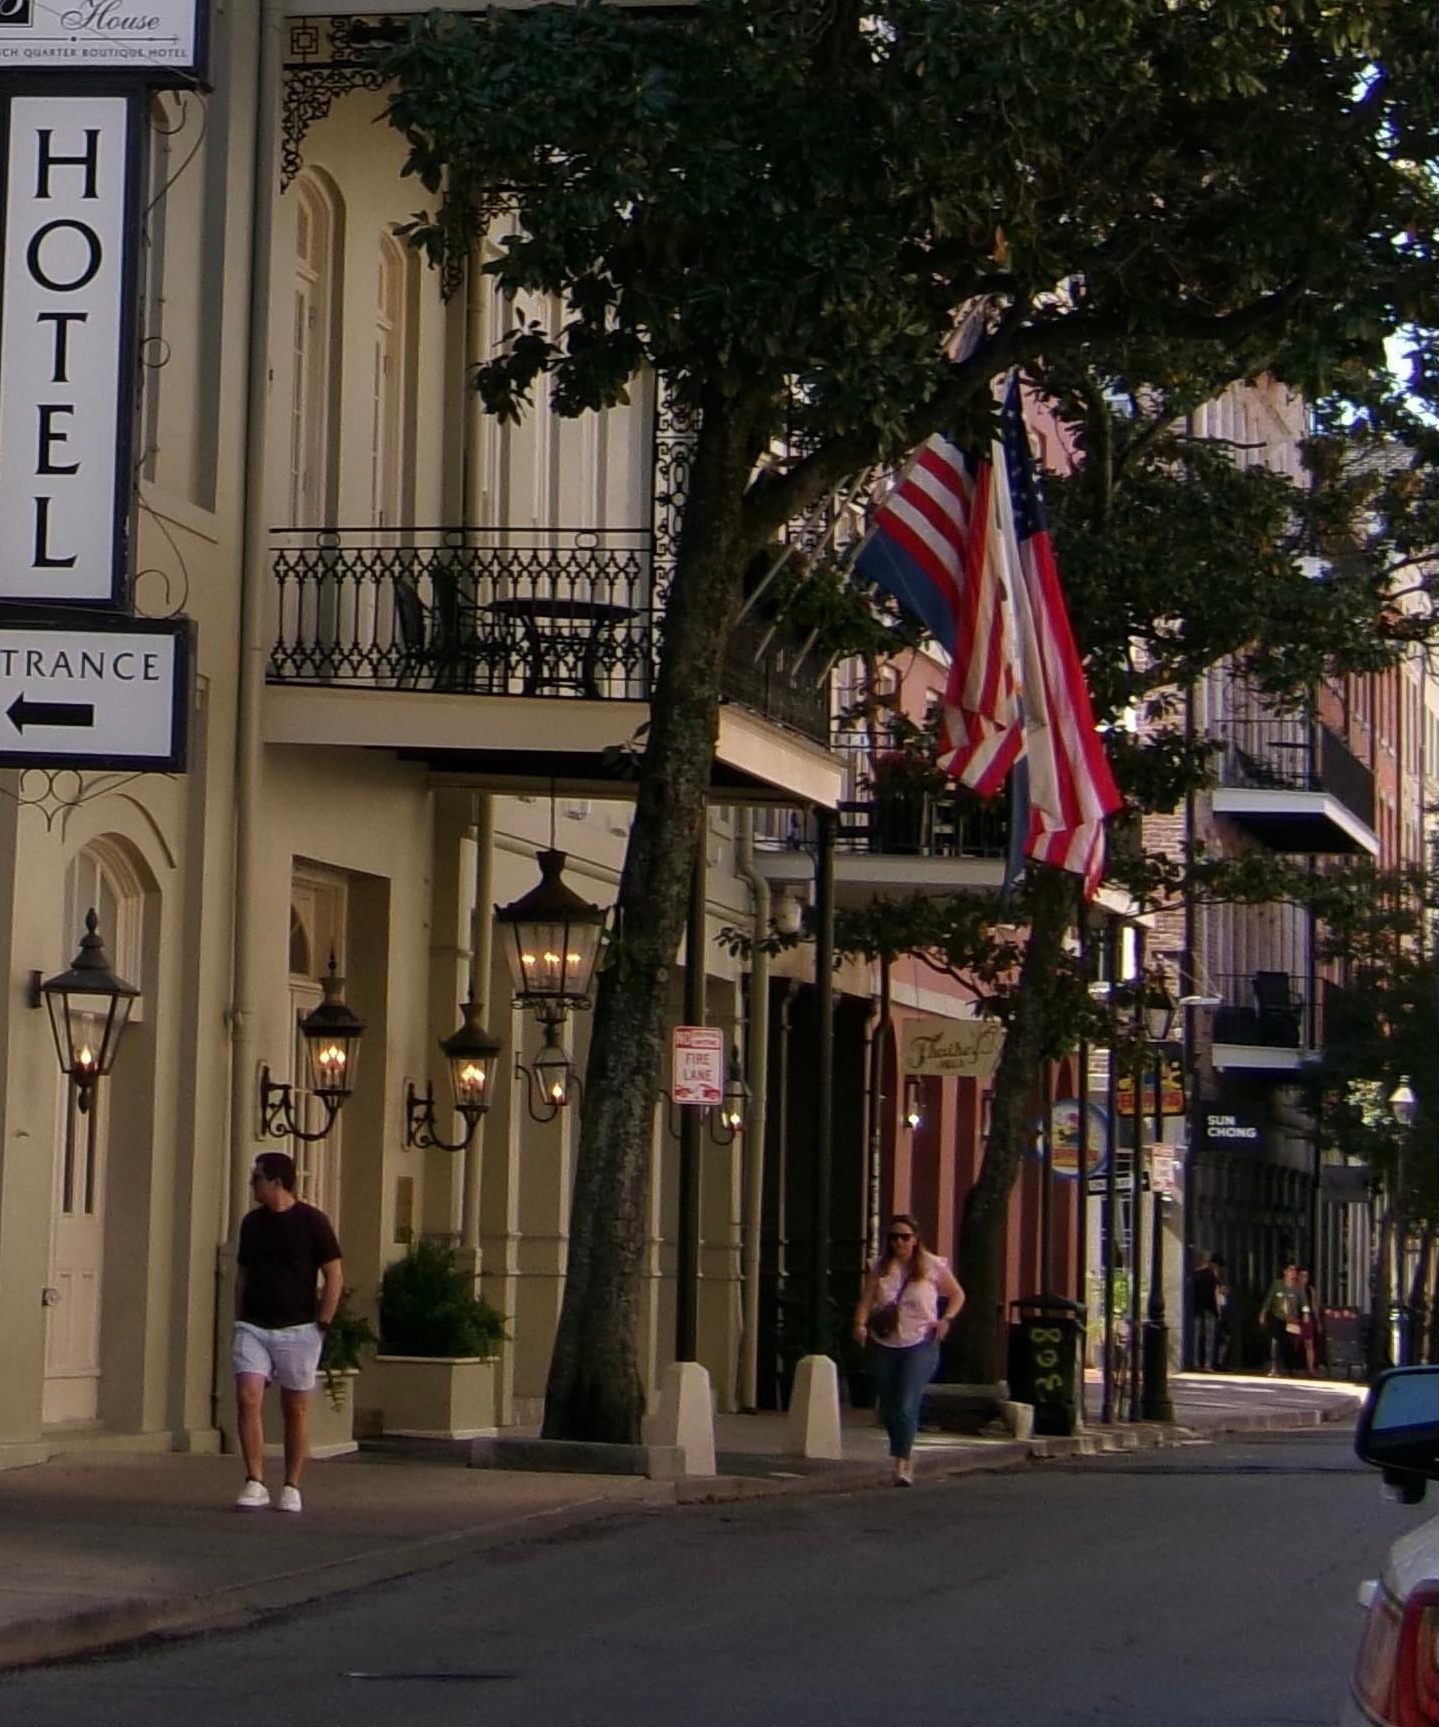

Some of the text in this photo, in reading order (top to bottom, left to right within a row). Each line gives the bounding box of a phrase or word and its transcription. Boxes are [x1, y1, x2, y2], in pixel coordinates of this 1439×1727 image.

[62, 0, 162, 30] House
[23, 48, 77, 58] QUARTER
[82, 48, 145, 58] BOUTIQUE
[148, 48, 187, 58] HOTEL
[26, 128, 103, 569] HOTEL
[686, 1053, 710, 1065] FIRE
[684, 1069, 713, 1081] LANE
[1207, 1115, 1236, 1126] SUN
[1207, 1127, 1258, 1138] CHONG
